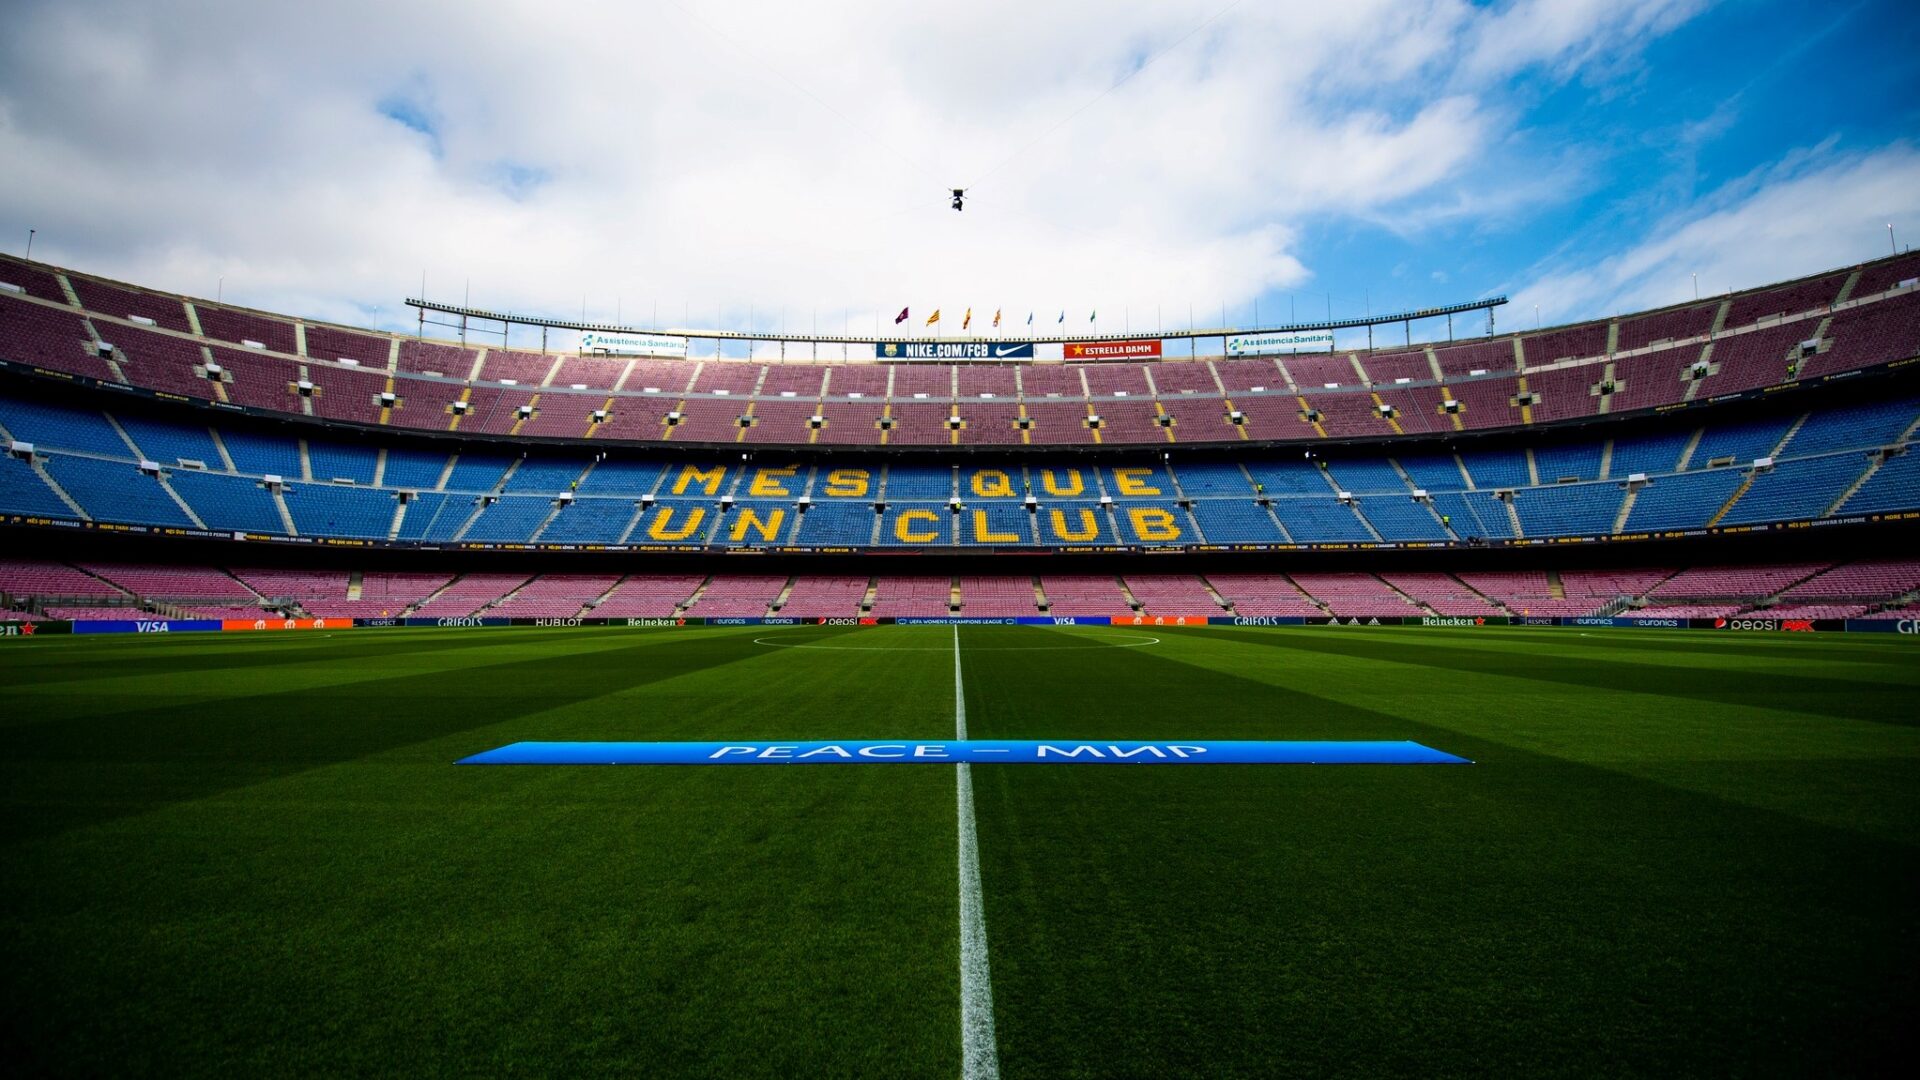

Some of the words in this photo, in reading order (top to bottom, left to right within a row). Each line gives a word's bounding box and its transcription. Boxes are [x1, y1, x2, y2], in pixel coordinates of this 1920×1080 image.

[1242, 336, 1293, 346] Assistència
[1294, 334, 1333, 343] Sanitària
[906, 344, 989, 357] NIKE.COM/FCB
[1085, 346, 1125, 355] ESTRELLA
[1126, 345, 1152, 353] DAMM
[672, 464, 870, 497] MÉS
[971, 467, 1161, 498] QUE
[647, 507, 785, 542] UN
[895, 507, 1181, 543] CLUB
[438, 617, 483, 627] GRIFOLS
[535, 618, 583, 627] HUBLOT
[628, 618, 676, 627] Heineken
[1054, 617, 1075, 626] VISA
[1234, 616, 1278, 626] GRIFOLS
[1422, 617, 1474, 626] Heineken
[1577, 618, 1613, 626] euronics
[1639, 619, 1678, 627] euronics
[1731, 619, 1778, 631] pepsi
[136, 621, 169, 633] VISA
[709, 745, 950, 758] PEACE
